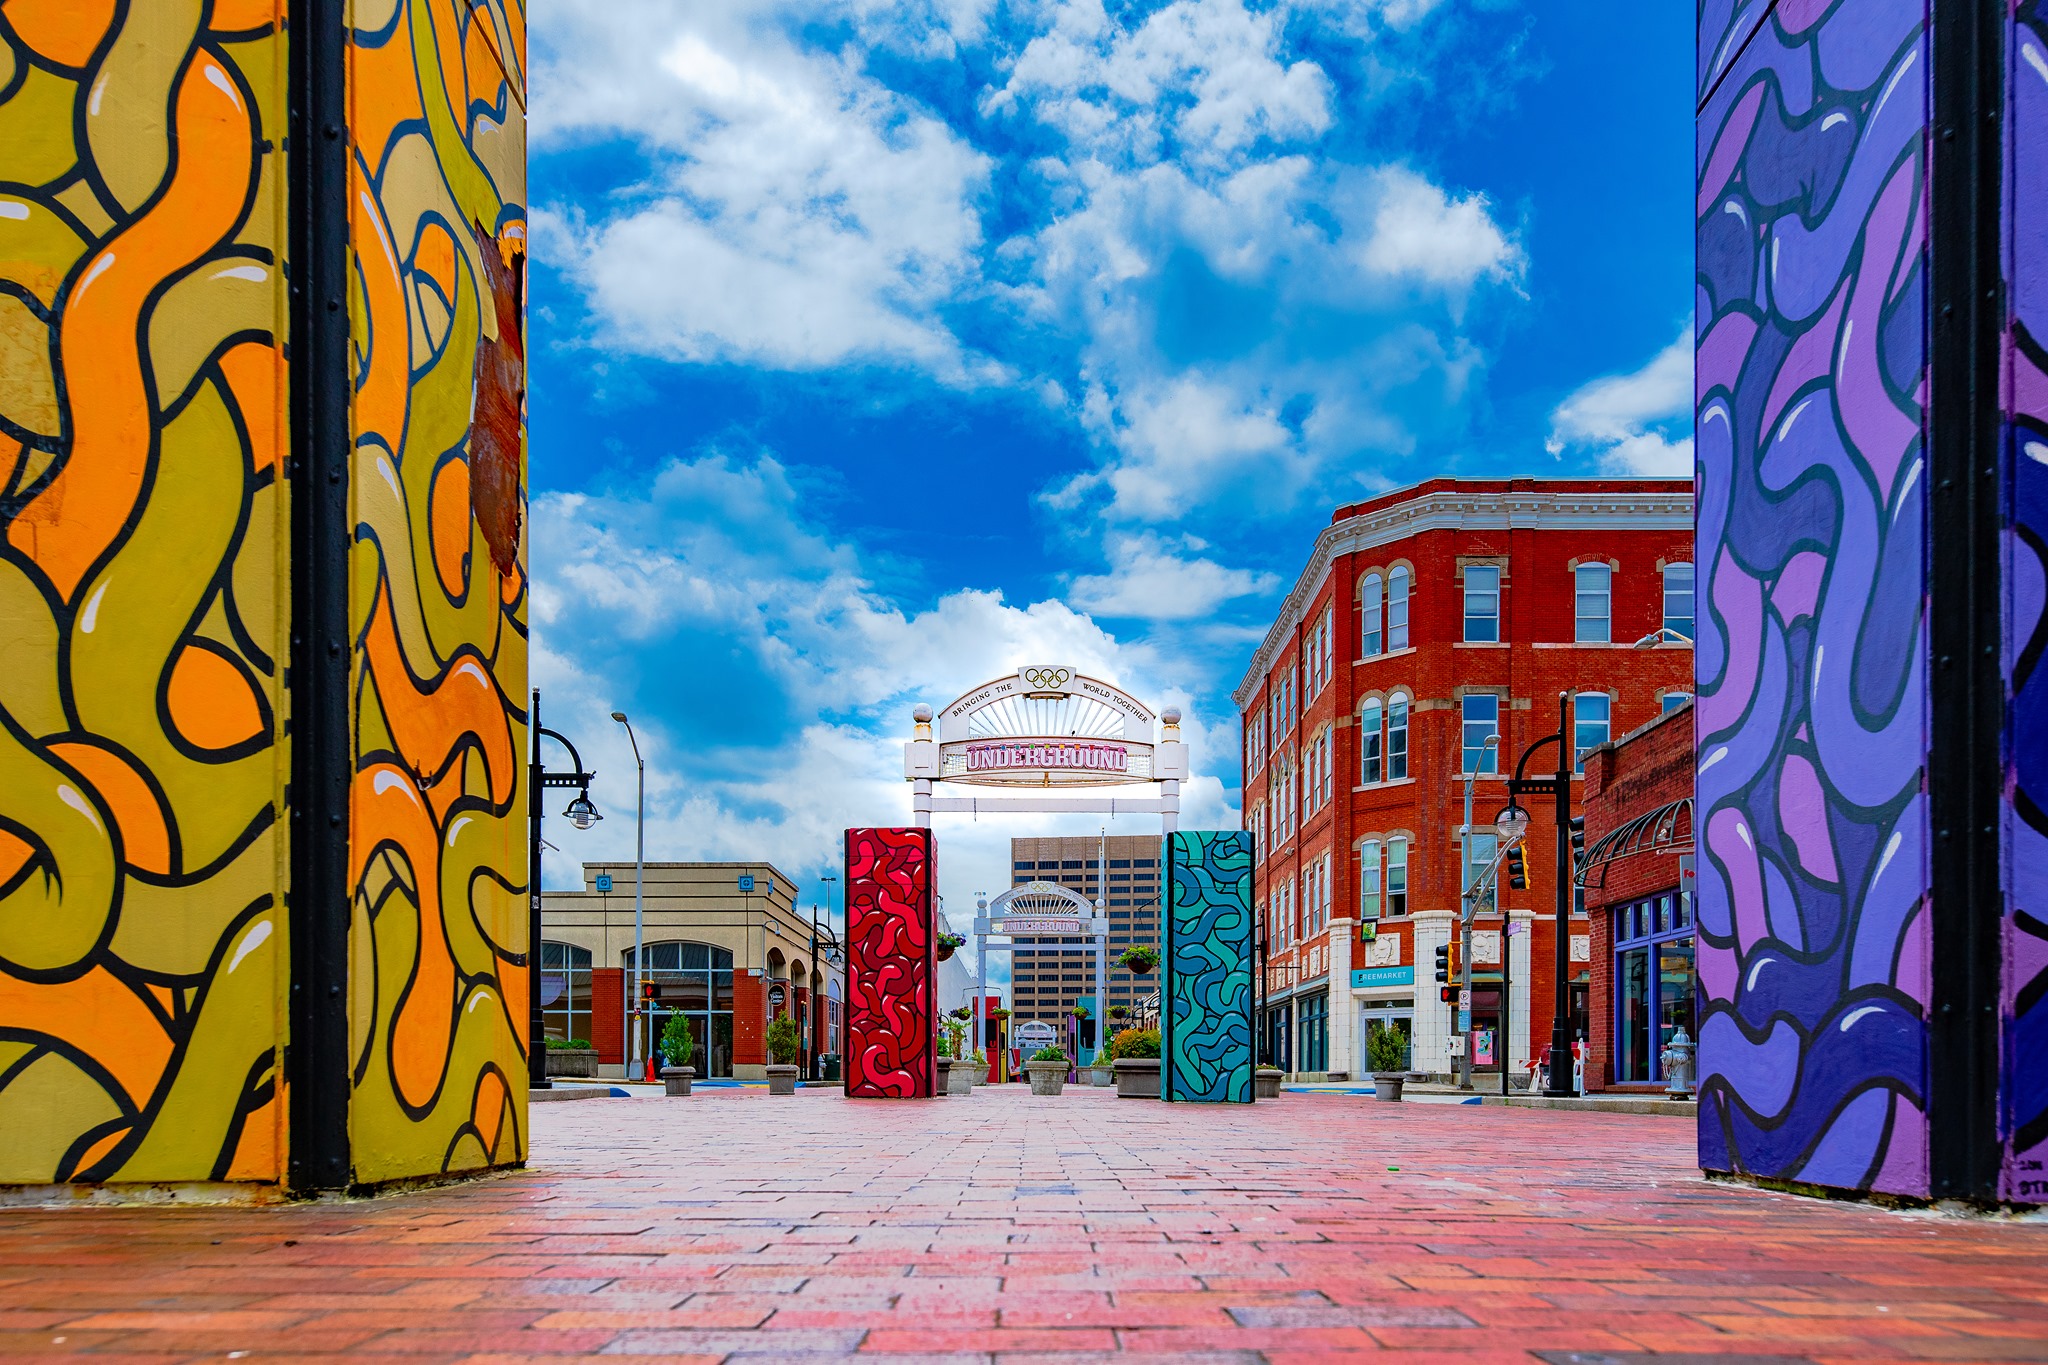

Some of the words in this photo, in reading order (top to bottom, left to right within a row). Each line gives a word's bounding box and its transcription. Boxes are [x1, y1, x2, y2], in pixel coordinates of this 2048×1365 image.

[952, 690, 990, 718] BRINGING
[995, 682, 1013, 694] THE
[1082, 683, 1110, 699] WORLD
[1112, 695, 1148, 724] TOGETHER
[966, 745, 1128, 772] UNDERGROUND
[1003, 921, 1079, 932] UNDERGROUND
[1358, 971, 1407, 981] FREEMARKET
